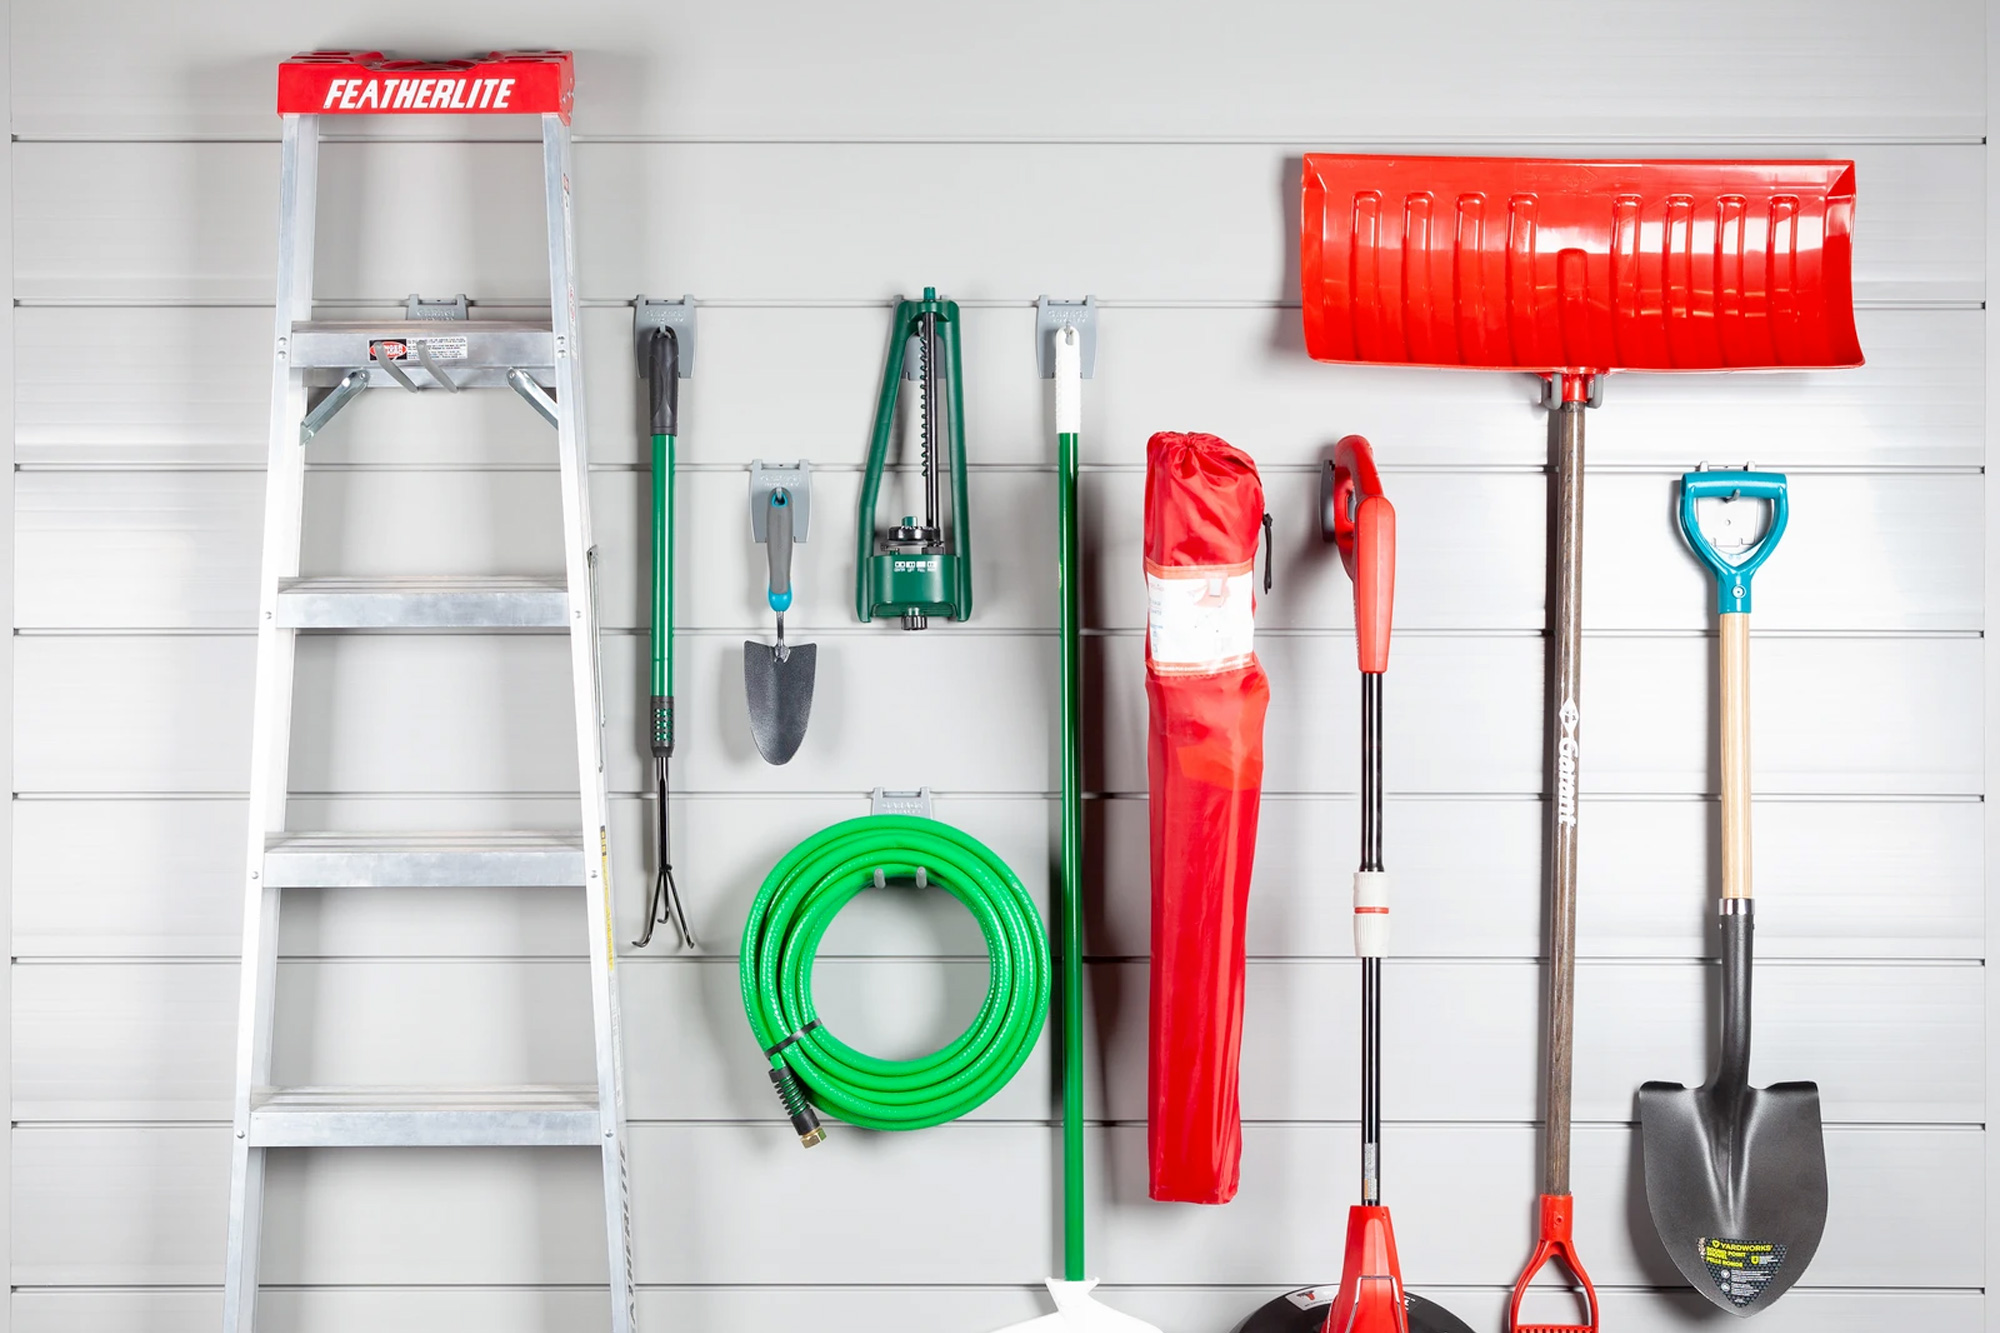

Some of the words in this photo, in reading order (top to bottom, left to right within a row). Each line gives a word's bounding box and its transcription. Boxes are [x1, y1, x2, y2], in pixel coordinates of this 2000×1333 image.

[323, 78, 516, 109] FEATHERLITE
[1558, 737, 1579, 827] Garant
[1720, 1242, 1773, 1252] YARDWORKS
